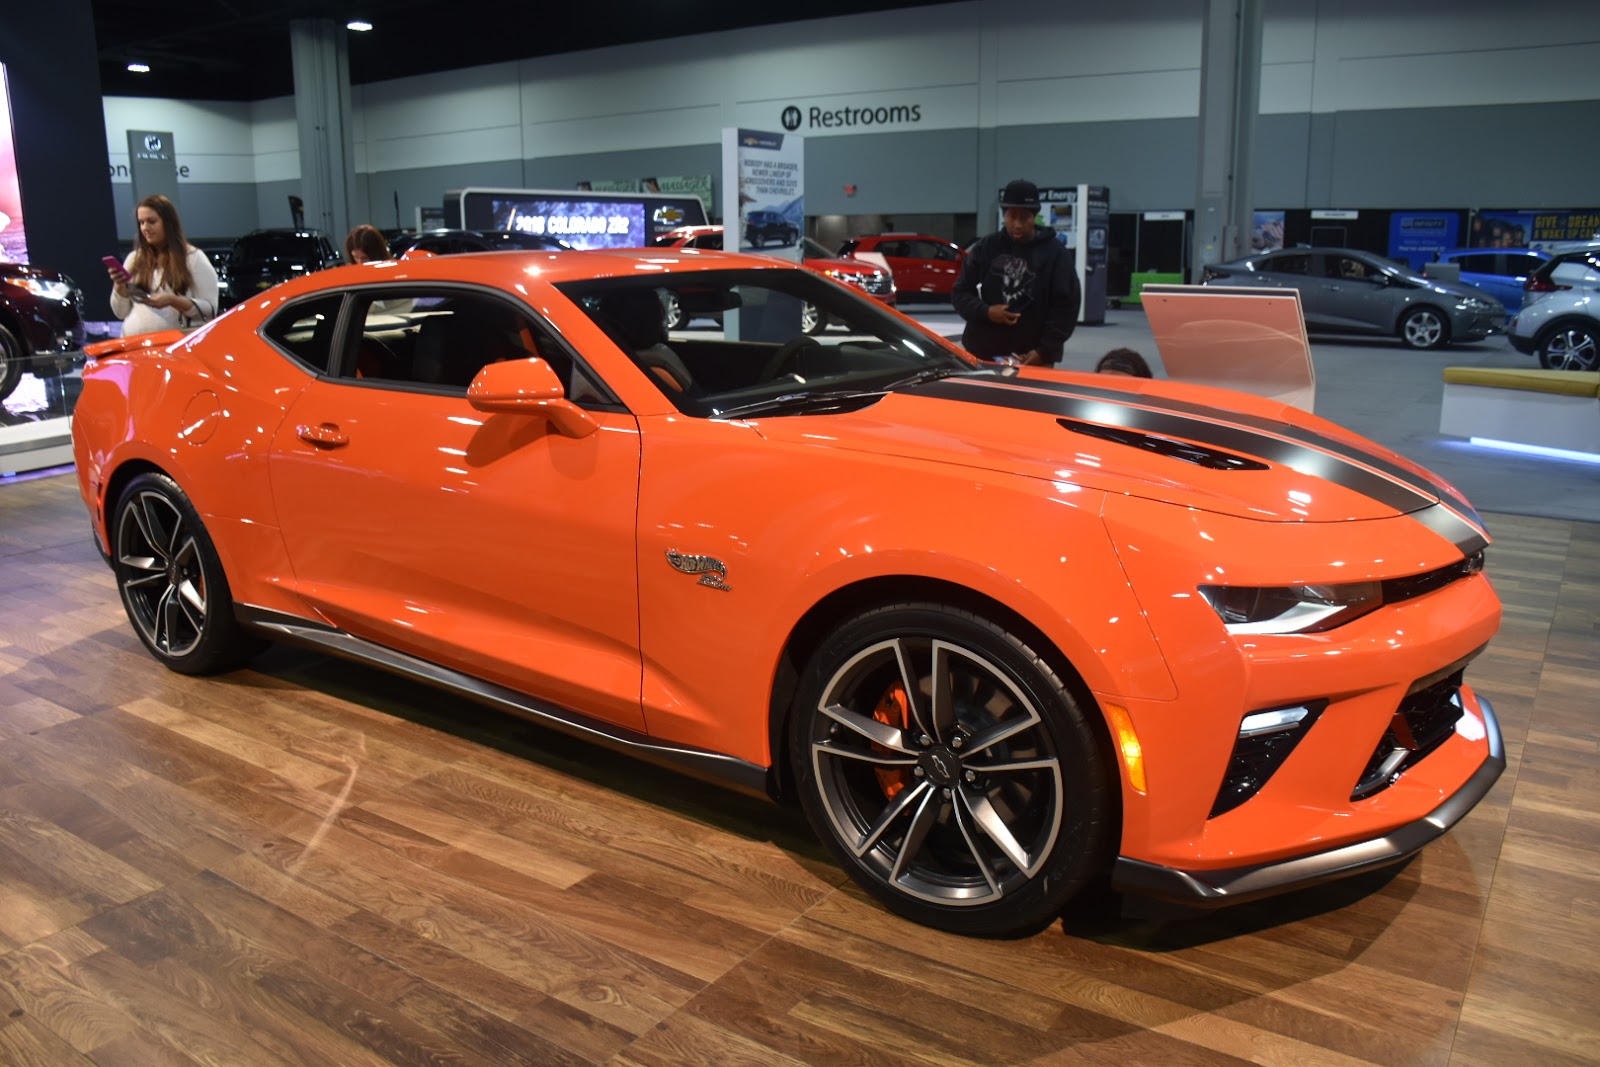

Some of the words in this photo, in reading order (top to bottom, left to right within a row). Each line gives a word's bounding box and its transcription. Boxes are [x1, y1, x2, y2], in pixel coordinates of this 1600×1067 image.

[808, 105, 921, 129] Restrooms
[1047, 190, 1077, 203] Energy
[547, 216, 607, 234] COLORADO
[1535, 215, 1558, 228] GIVE
[1541, 229, 1566, 239] WAKE
